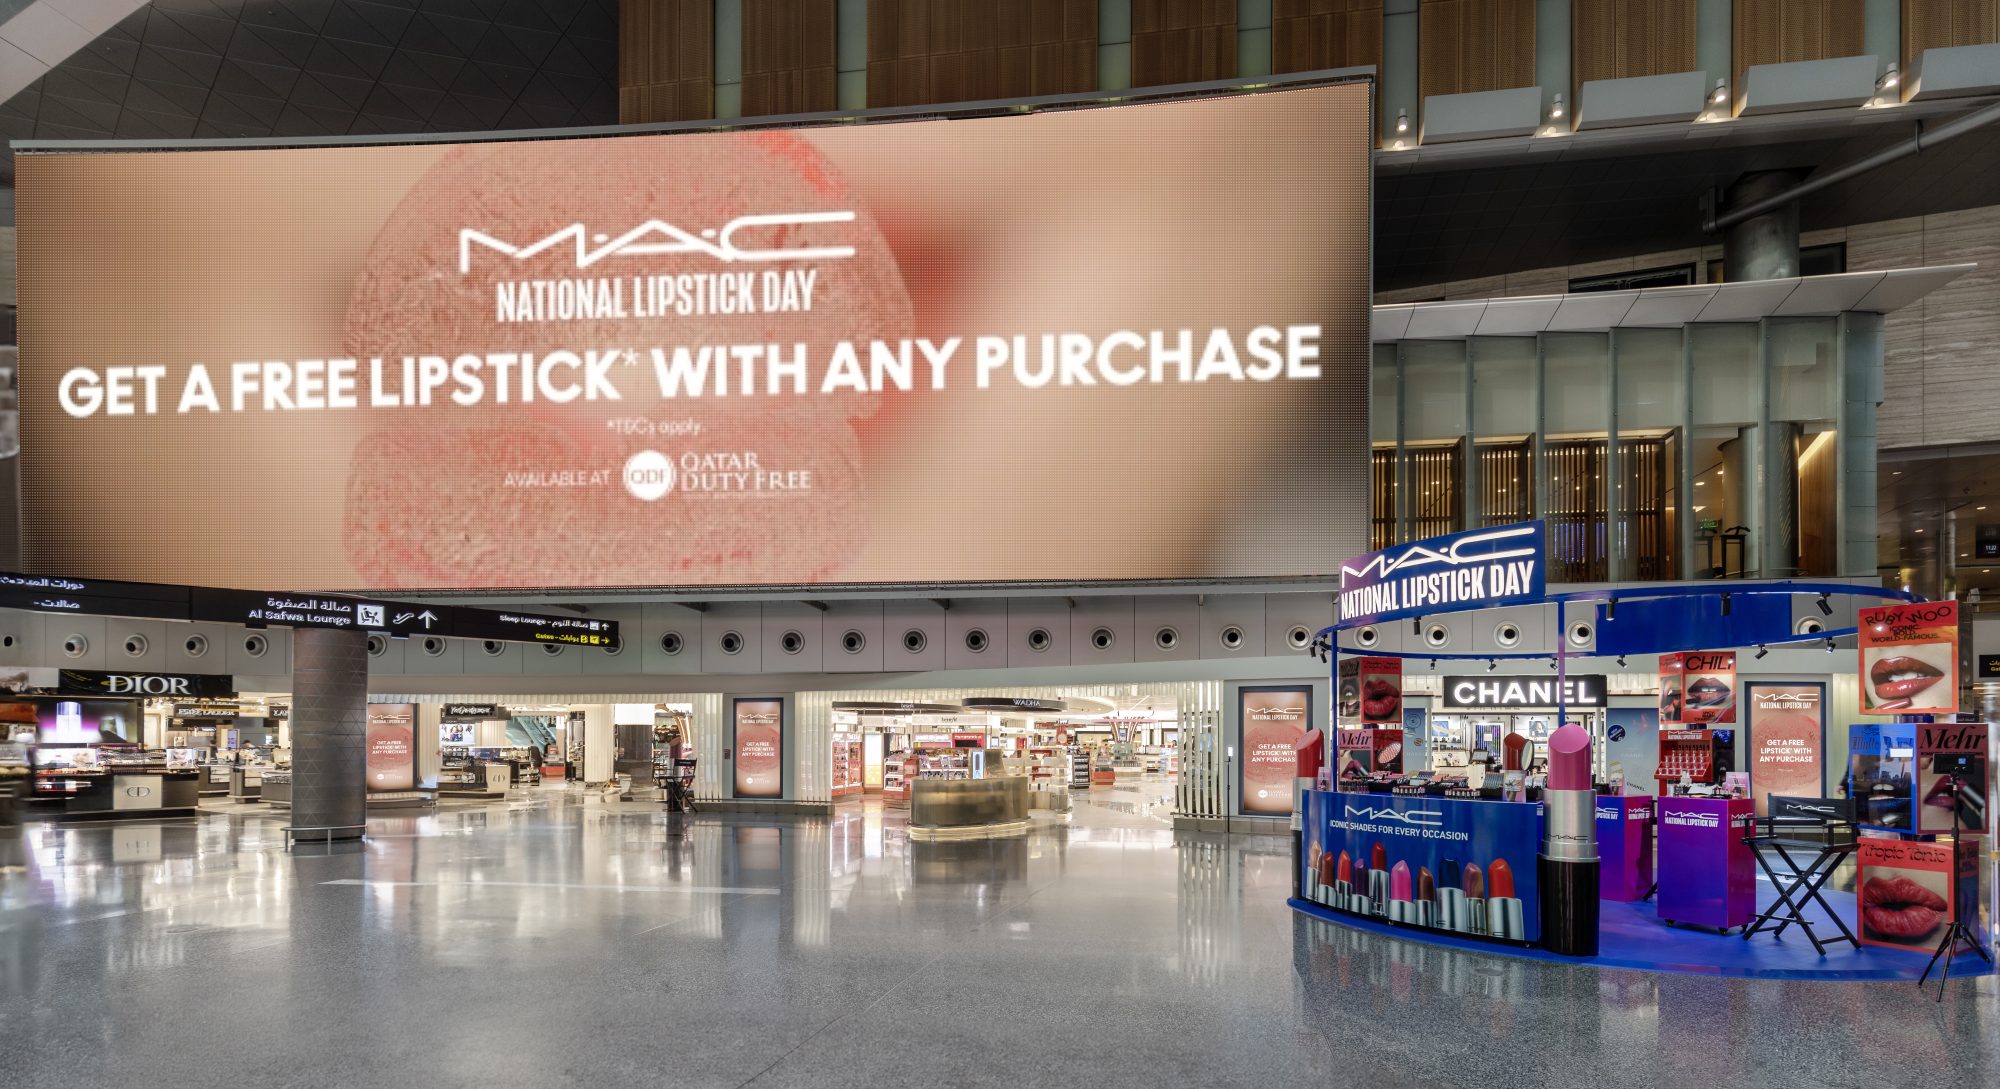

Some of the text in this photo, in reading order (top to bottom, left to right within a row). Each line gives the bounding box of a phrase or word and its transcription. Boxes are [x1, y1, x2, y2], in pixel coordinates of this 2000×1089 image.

[497, 269, 817, 322] NATIONAL LIPSTICK DAY
[58, 364, 166, 418] GET
[178, 364, 220, 413] A
[231, 360, 357, 412] FREE
[650, 342, 807, 399] WITH
[821, 337, 962, 393] ANY
[976, 325, 1322, 389] PURCHASE
[680, 451, 762, 473] QATAR
[503, 468, 611, 488] AVAILABLE AT
[680, 471, 812, 492] DUTY FREE
[1340, 560, 1535, 621] NATIONAL LIPSTICK DAY
[320, 600, 352, 612] صالة
[248, 609, 352, 626] Al Safwa Lounge
[499, 614, 547, 626] Sleep Lounge
[1864, 606, 1952, 627] RUBY WOO
[107, 675, 192, 695] DIOR
[1453, 681, 1597, 705] CHANEL
[1339, 730, 1372, 745] Mehr
[1919, 725, 1986, 750] Mehr
[1759, 755, 1813, 763] ANY PURCHASE
[1329, 819, 1469, 841] ICONIC SHADES FOR EVERY OCCASION
[1664, 817, 1719, 828] NATIONAL LIPSTICK DAY
[1861, 843, 1905, 862] Tropic
